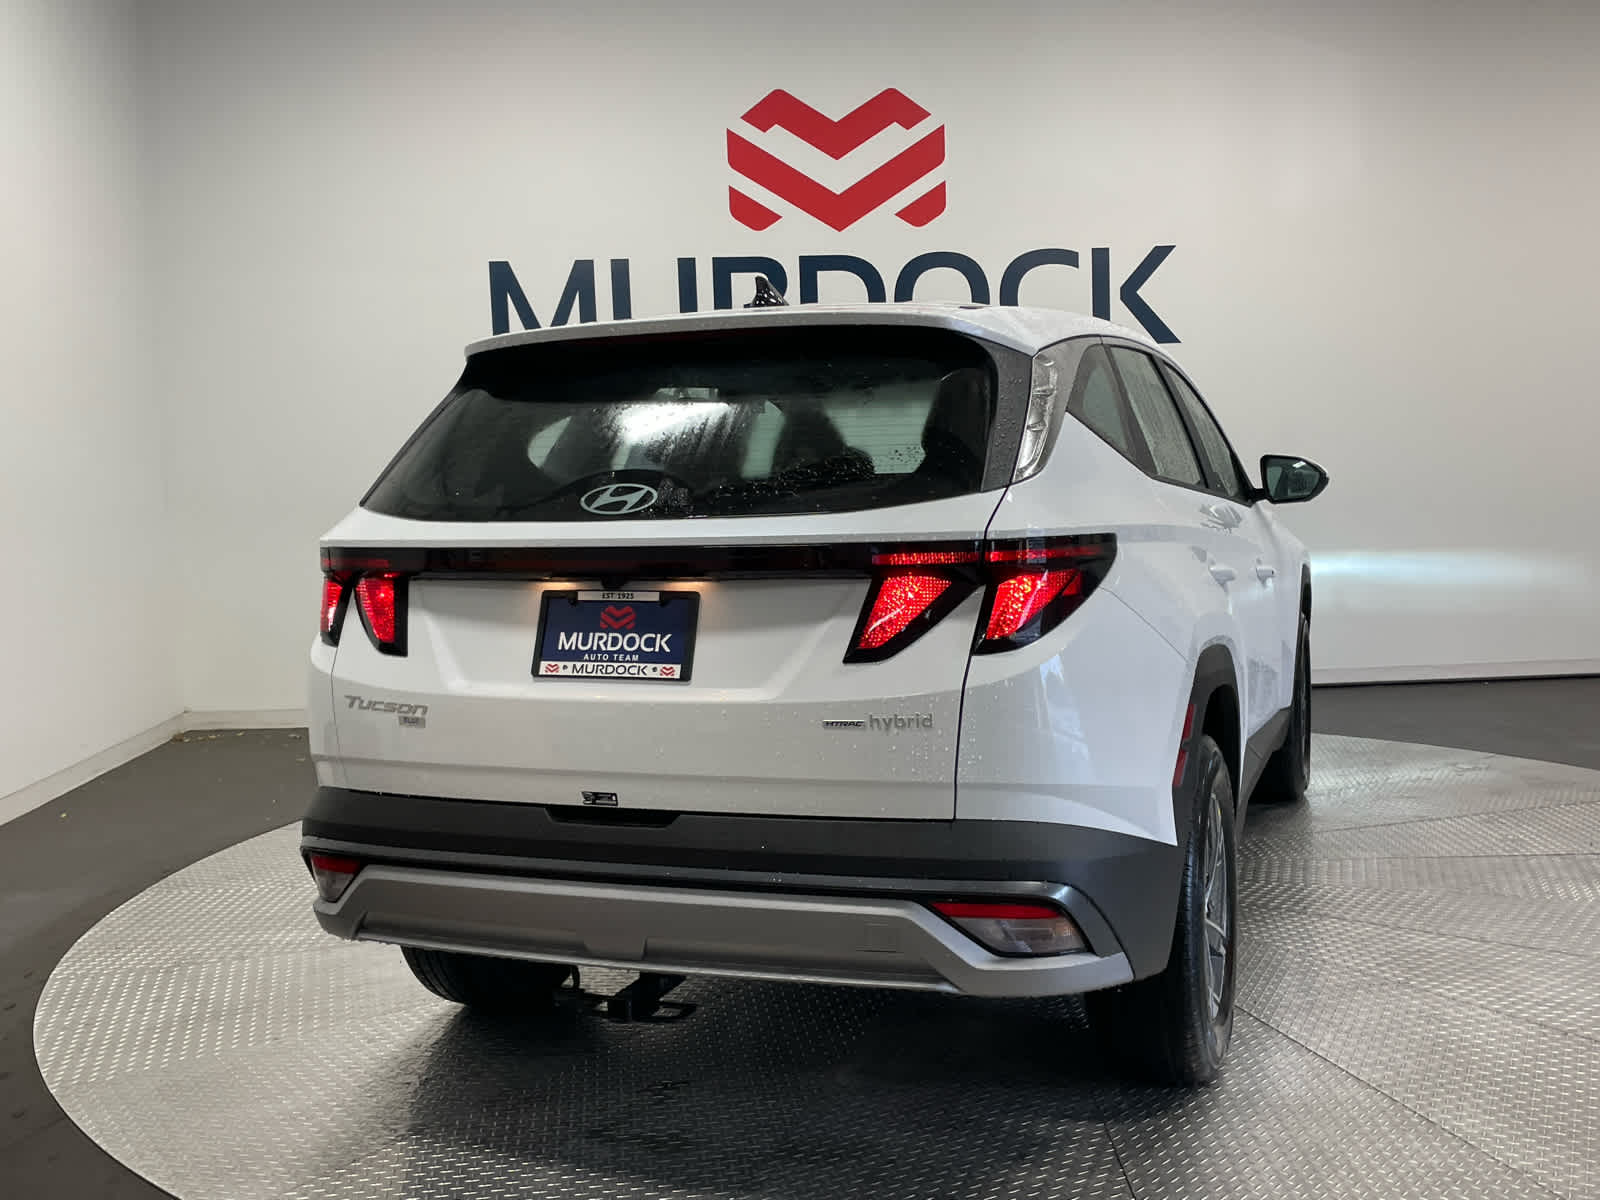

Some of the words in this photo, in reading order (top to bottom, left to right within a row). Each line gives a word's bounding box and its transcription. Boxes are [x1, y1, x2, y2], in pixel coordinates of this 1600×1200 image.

[558, 631, 672, 653] MURDOCK
[583, 653, 609, 661] AUTO
[613, 654, 639, 662] TEAM
[571, 663, 648, 676] MURDOCK
[869, 713, 934, 733] hybrid
